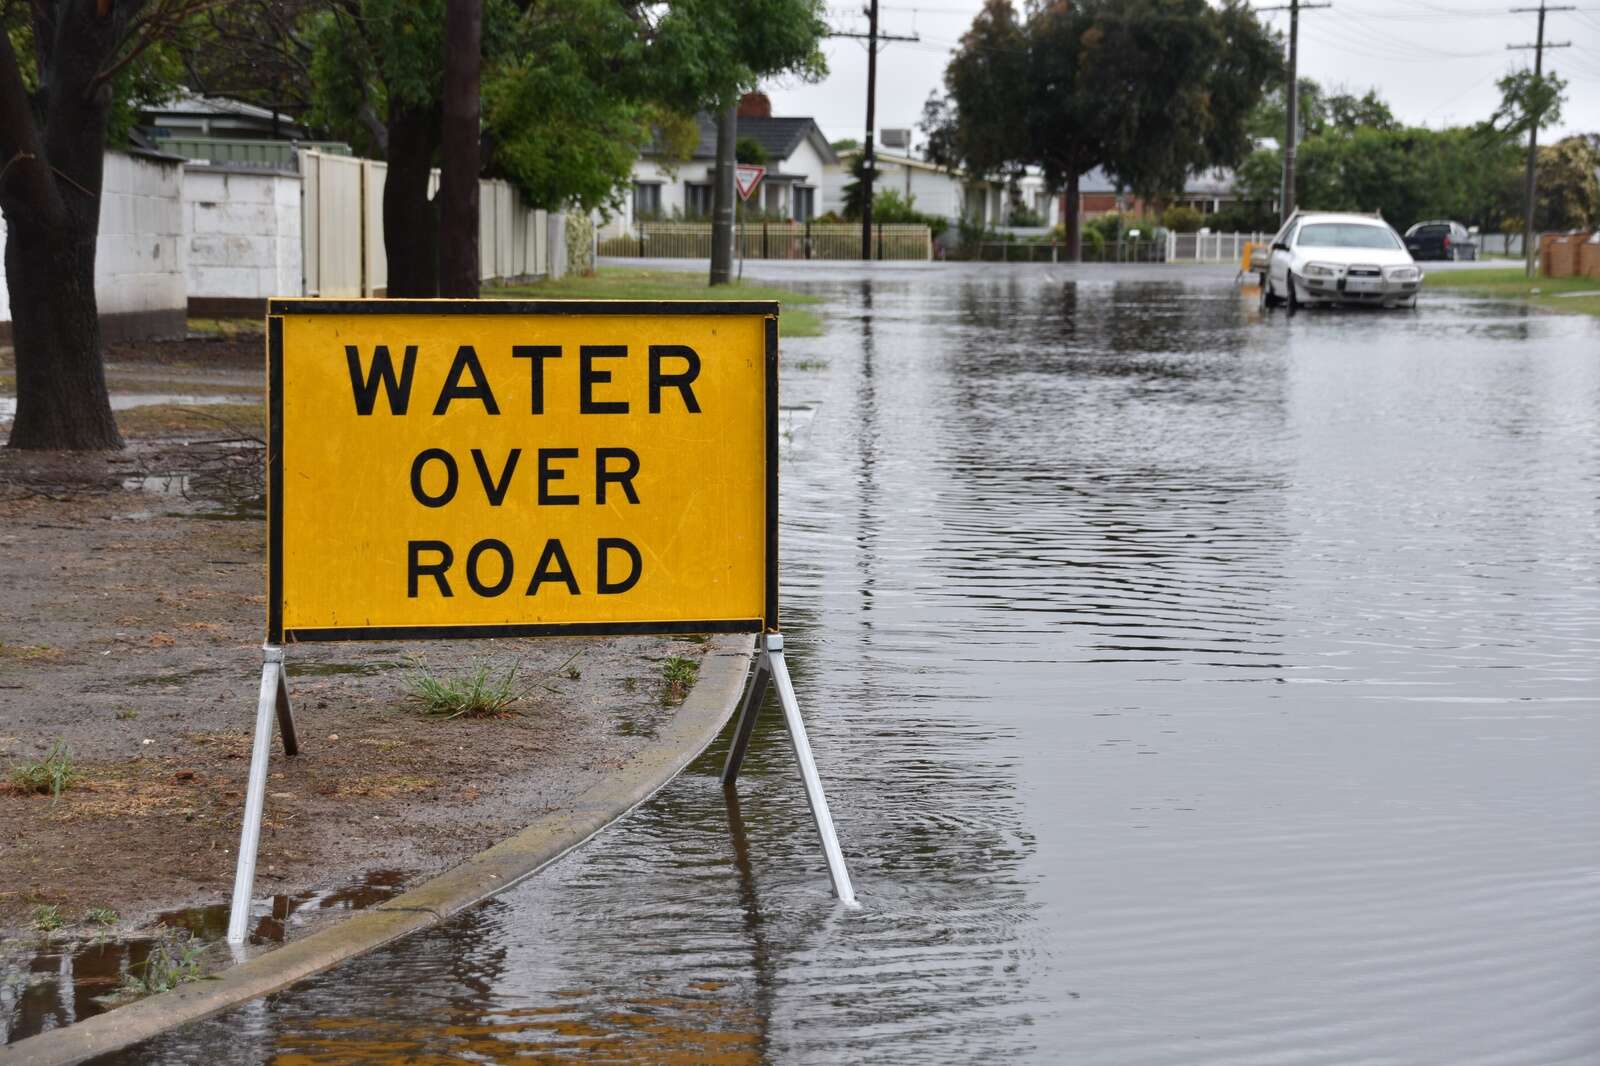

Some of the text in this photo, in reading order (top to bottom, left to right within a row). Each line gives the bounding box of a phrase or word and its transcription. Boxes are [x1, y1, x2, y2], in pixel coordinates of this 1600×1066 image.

[345, 345, 701, 415] WATER
[411, 448, 640, 508] OVER
[408, 538, 642, 597] ROAD
